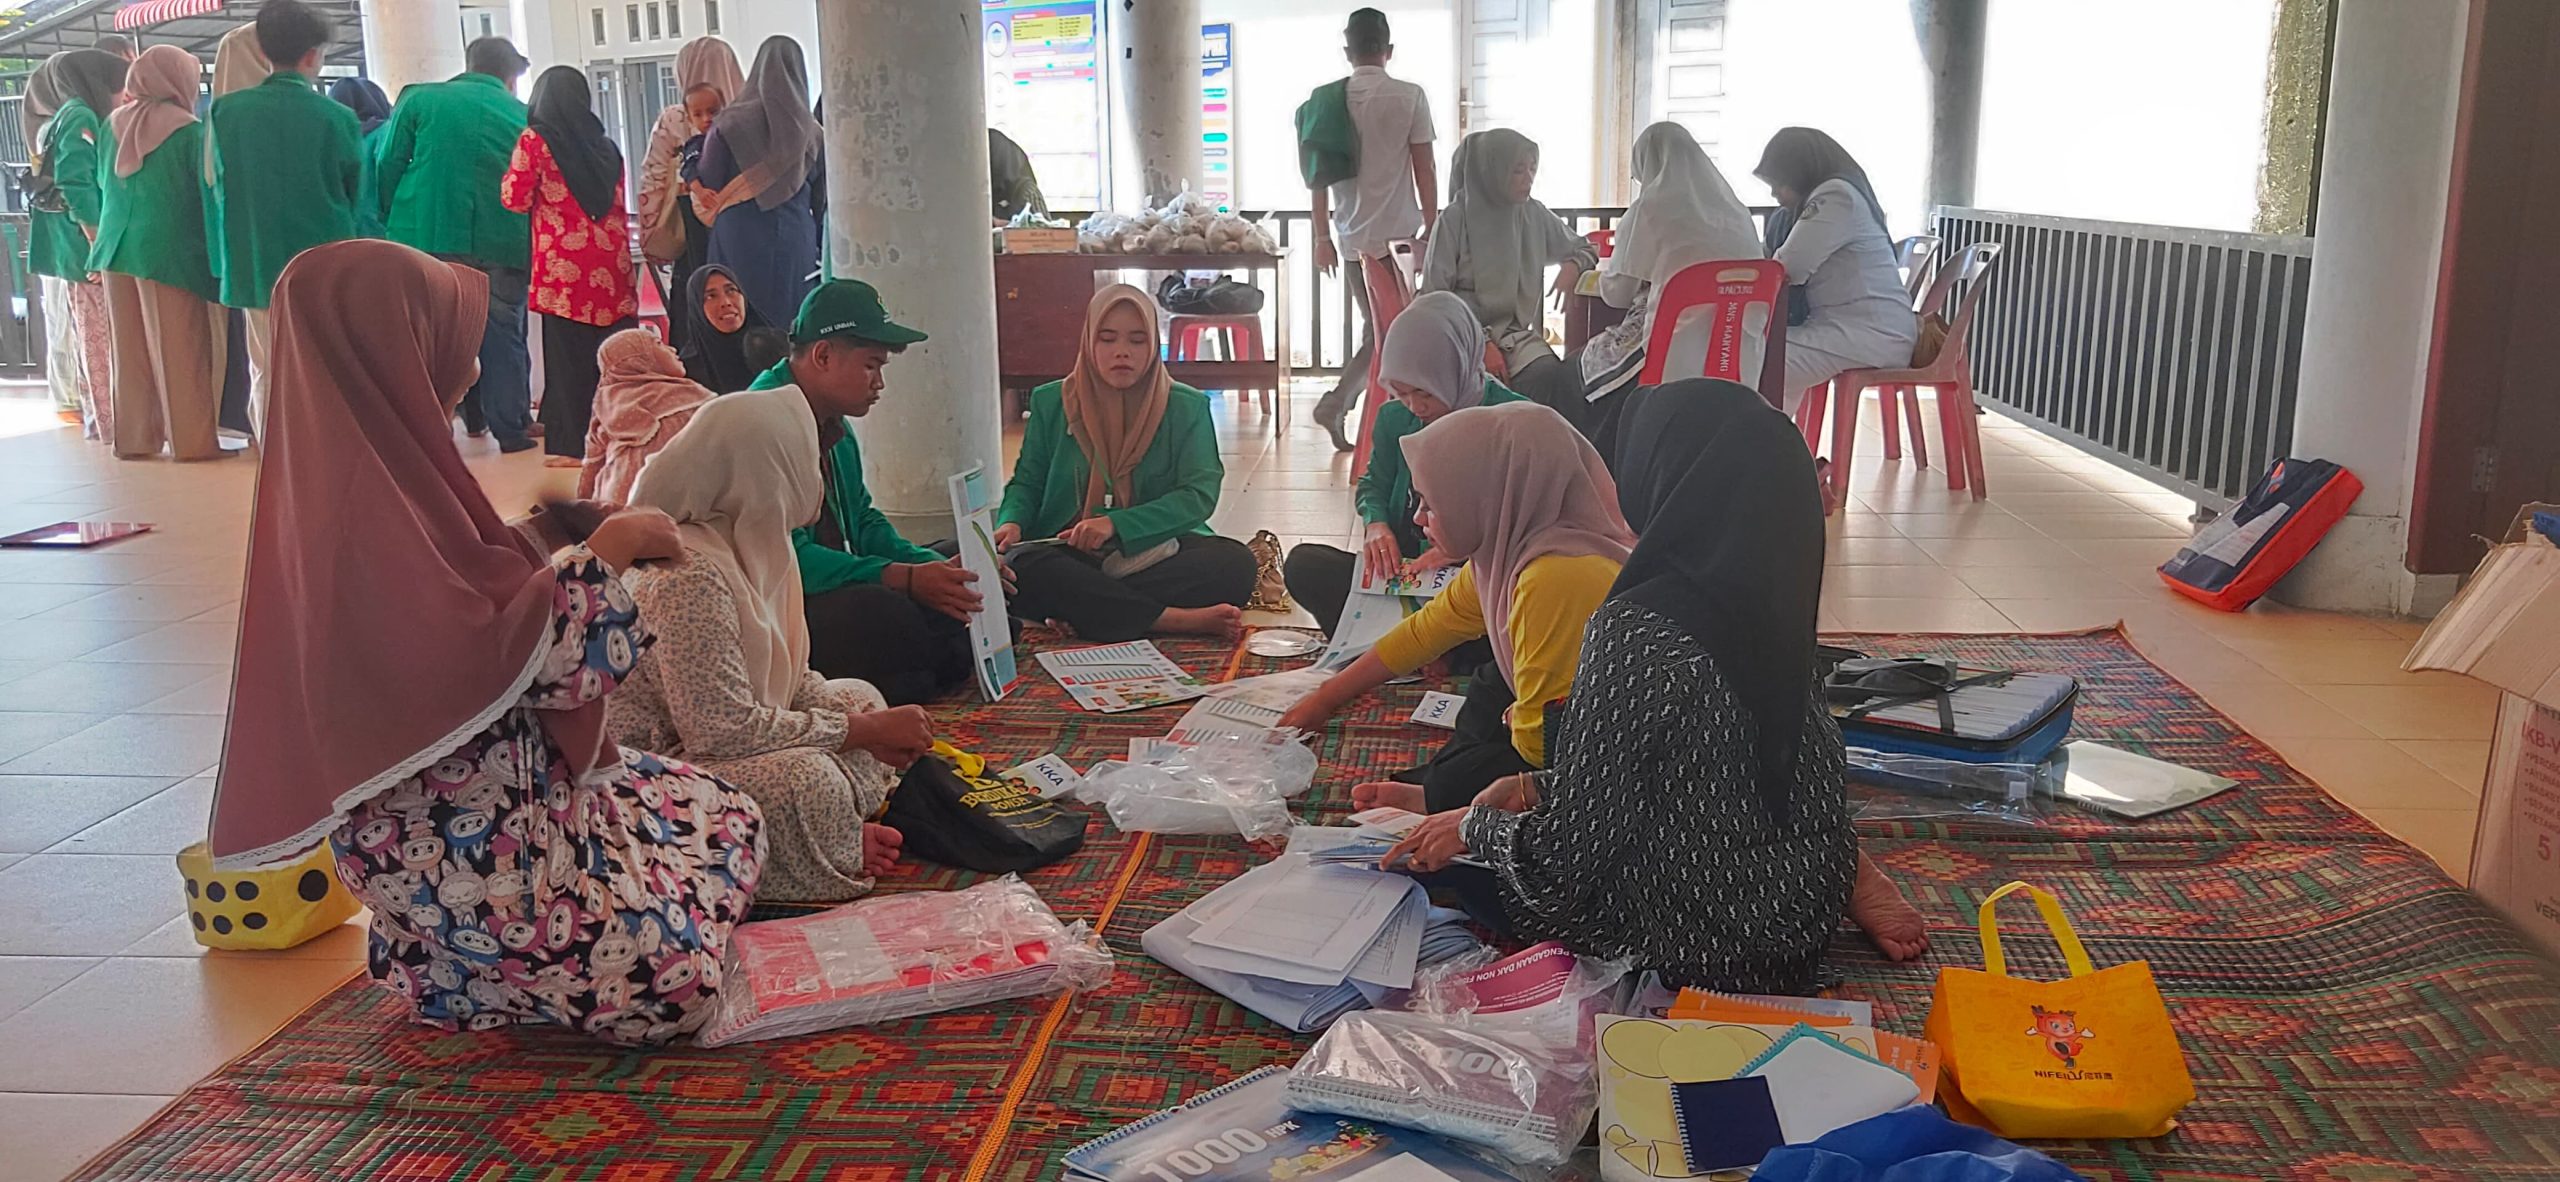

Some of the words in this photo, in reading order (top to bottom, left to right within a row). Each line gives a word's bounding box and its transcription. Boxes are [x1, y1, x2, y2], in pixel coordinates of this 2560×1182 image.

[1429, 700, 1449, 720] KKA
[1036, 763, 1064, 786] KKA
[2537, 834, 2551, 861] 5
[1497, 962, 1515, 977] DAK
[1516, 947, 1570, 970] PENGADAAN
[1476, 970, 1496, 983] NON
[1139, 1127, 1268, 1182] 1000
[1264, 1119, 1301, 1139] HPK
